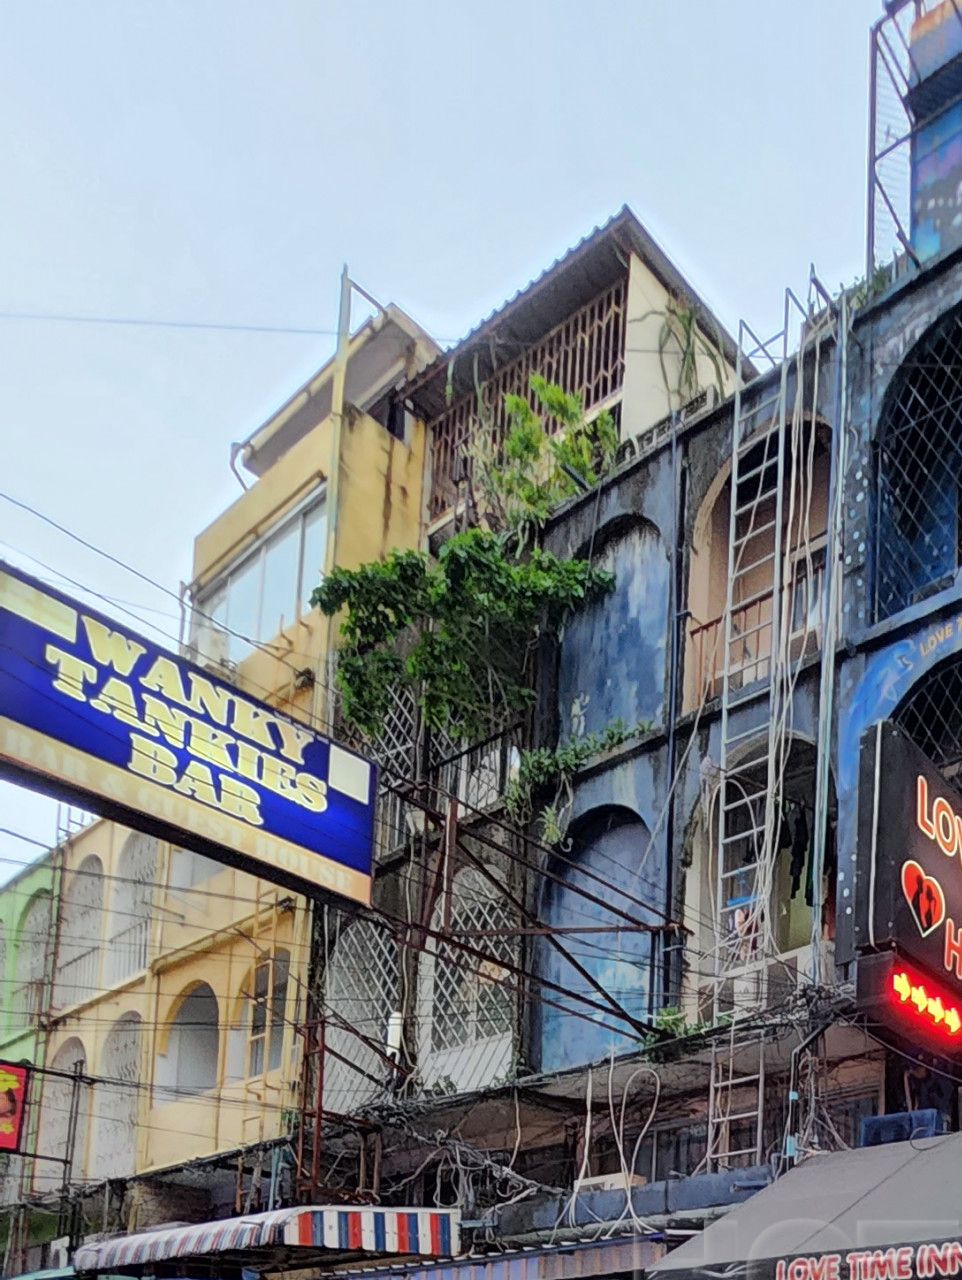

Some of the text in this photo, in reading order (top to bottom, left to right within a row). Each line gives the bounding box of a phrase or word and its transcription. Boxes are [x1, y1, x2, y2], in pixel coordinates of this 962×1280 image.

[81, 614, 314, 766] WANKY
[919, 622, 954, 656] LOVE
[45, 644, 329, 813] TANKIES
[127, 732, 264, 826] BAR
